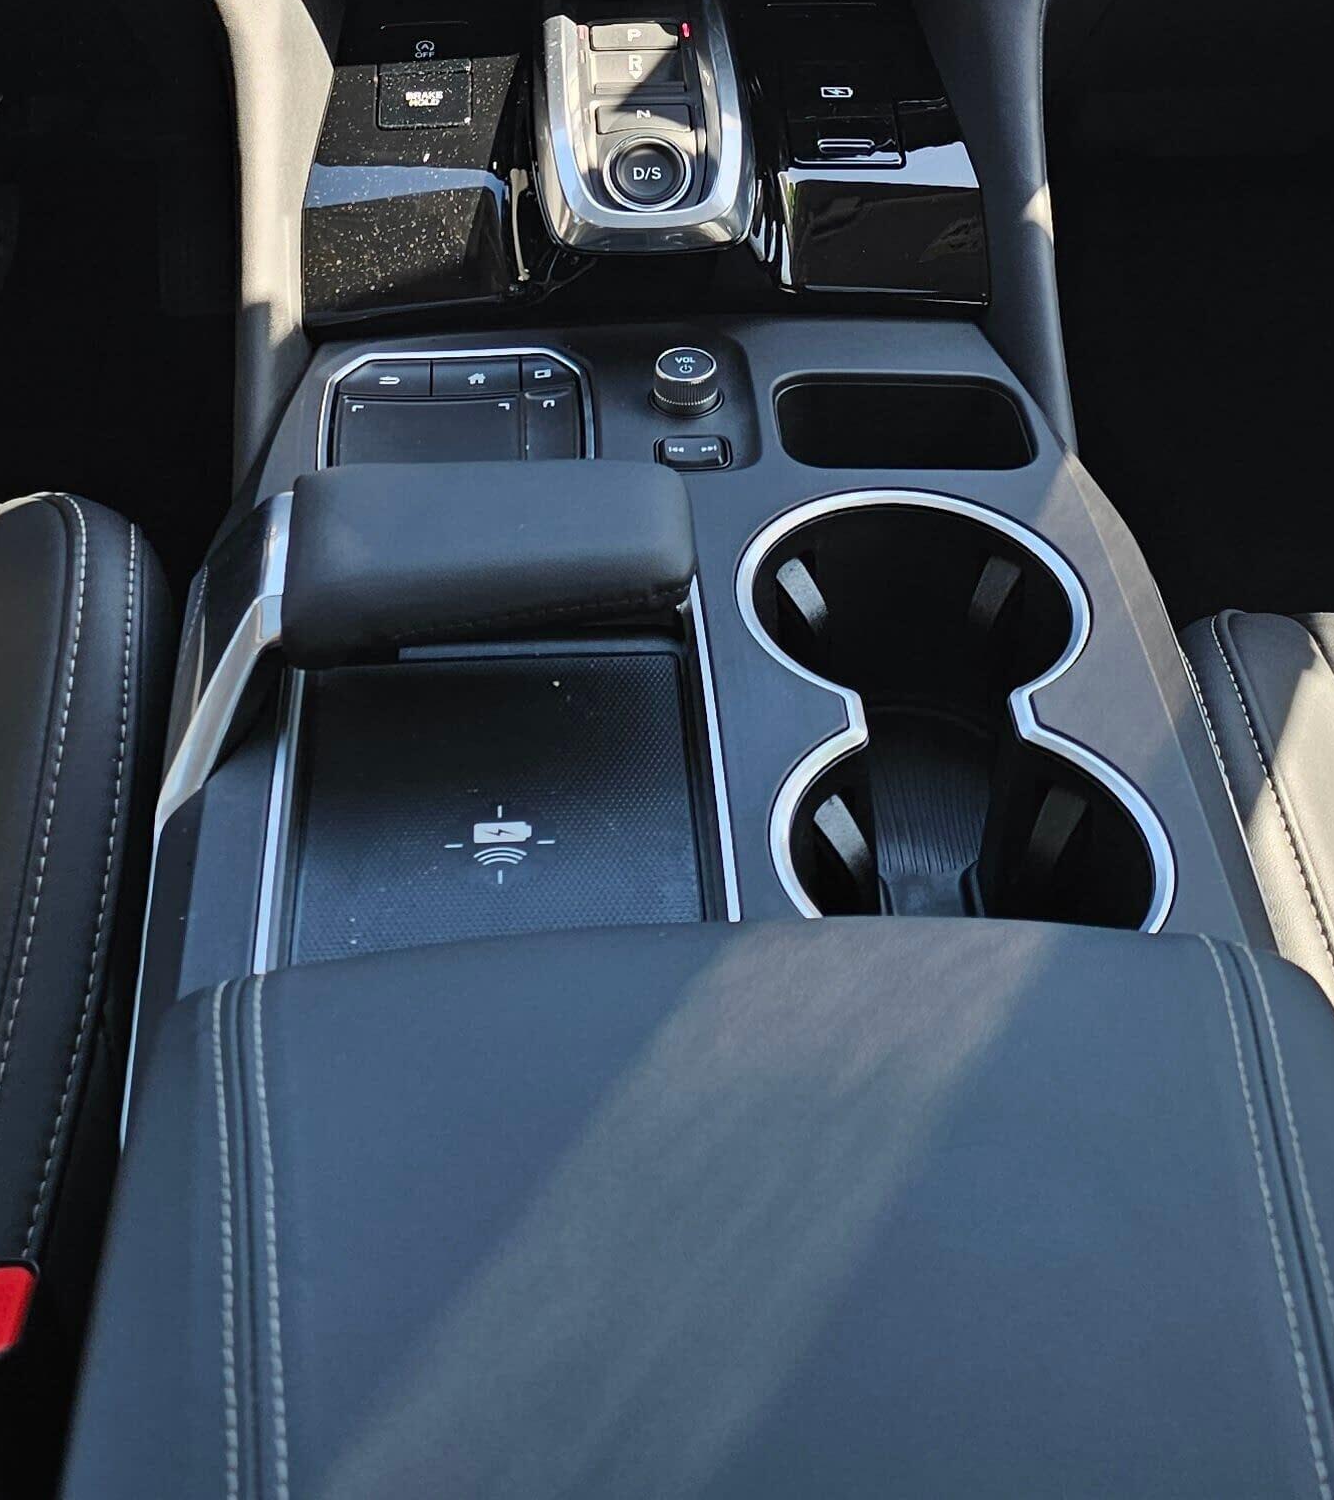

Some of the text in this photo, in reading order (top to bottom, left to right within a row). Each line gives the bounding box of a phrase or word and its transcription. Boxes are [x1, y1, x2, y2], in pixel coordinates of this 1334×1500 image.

[627, 28, 642, 42] P
[628, 55, 643, 71] R
[405, 90, 444, 100] BRAKE
[633, 167, 662, 181] D/S
[674, 356, 696, 364] VOL
